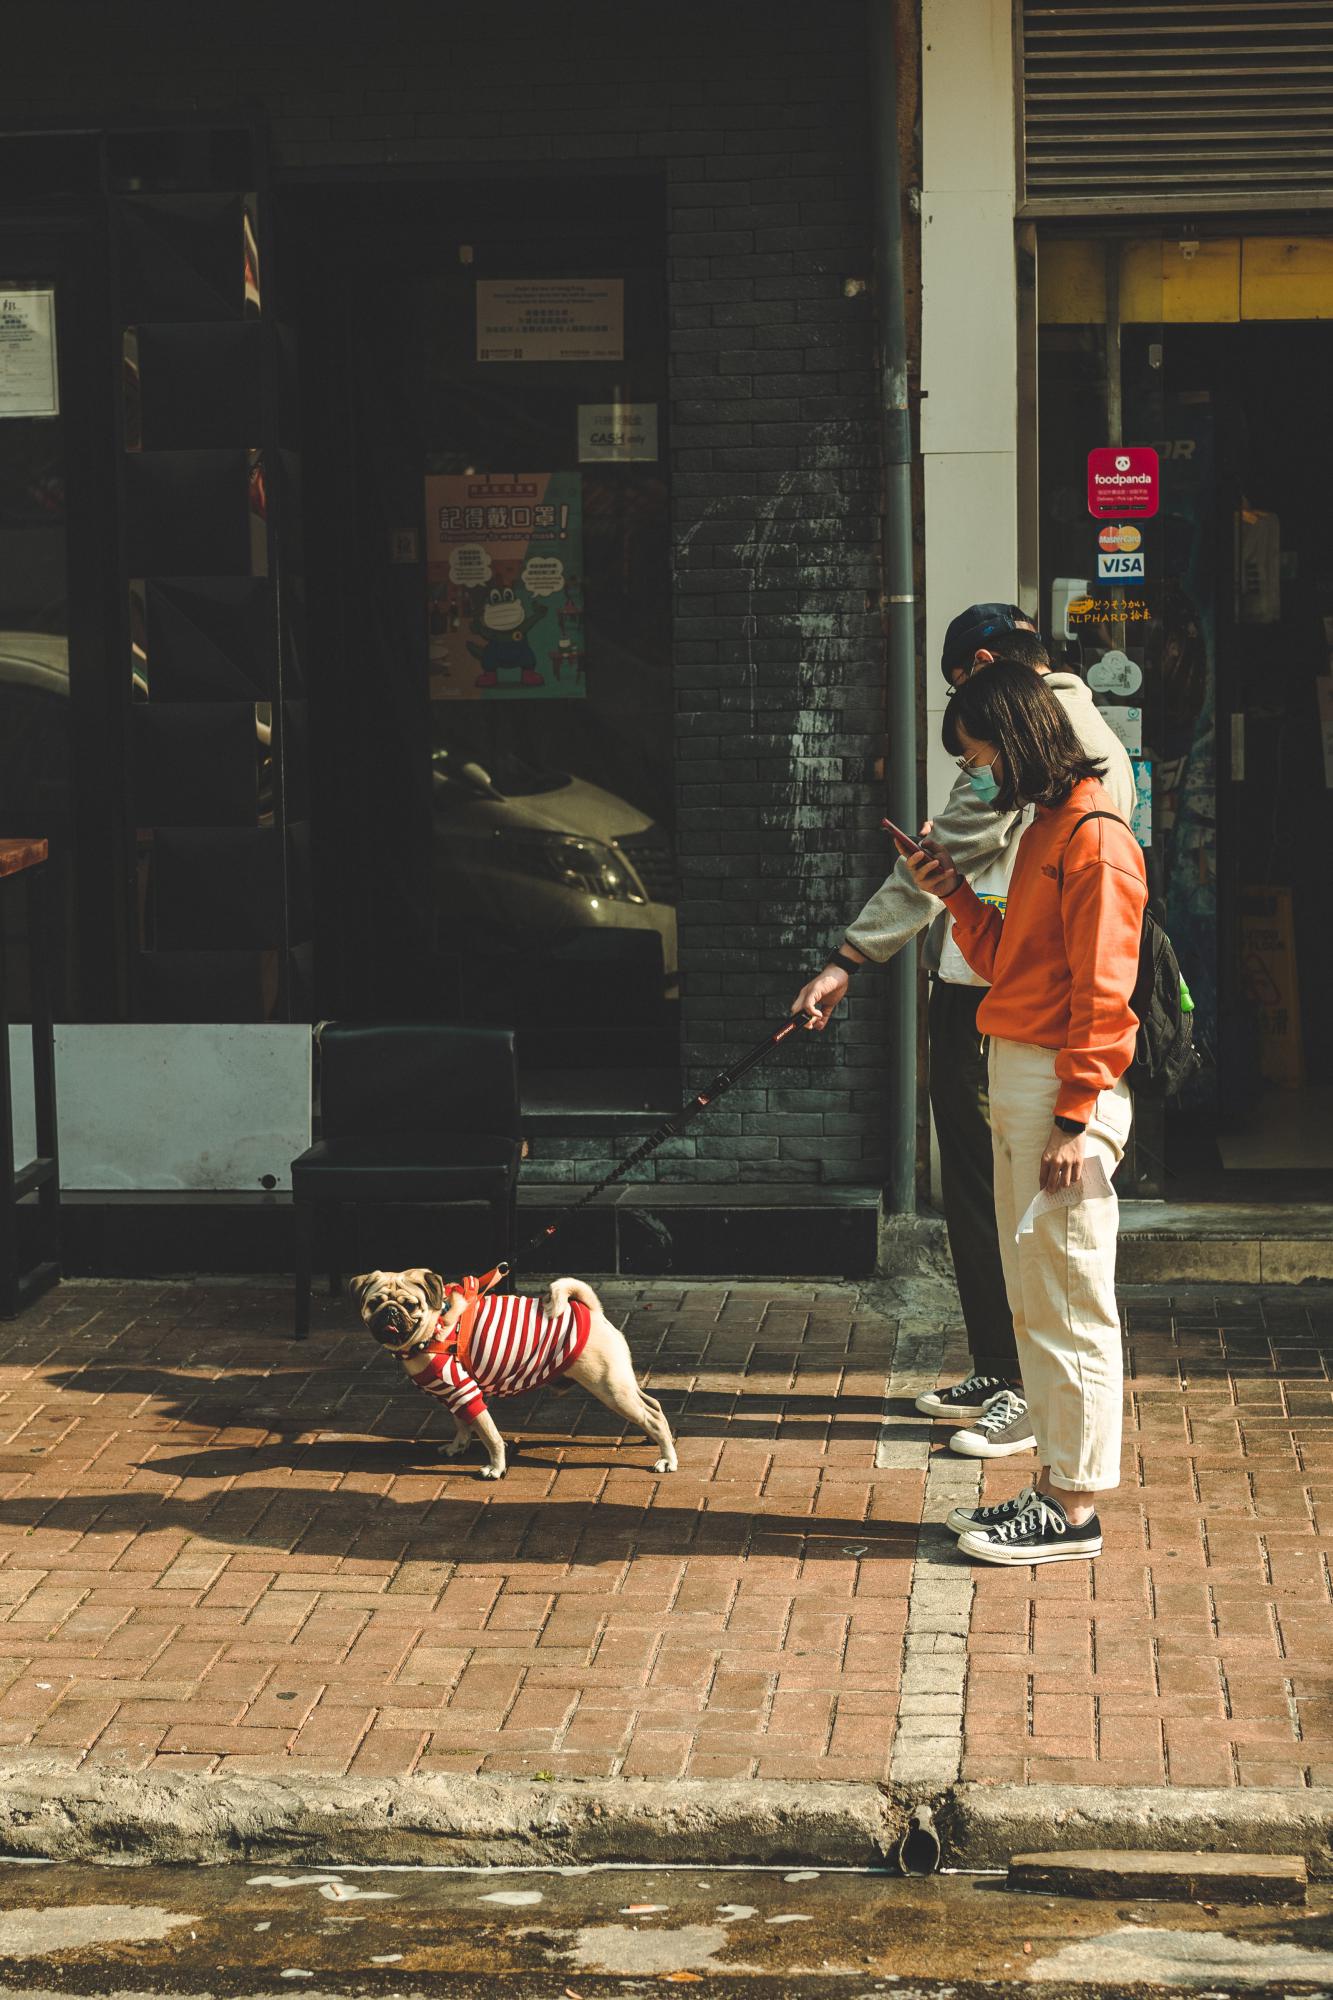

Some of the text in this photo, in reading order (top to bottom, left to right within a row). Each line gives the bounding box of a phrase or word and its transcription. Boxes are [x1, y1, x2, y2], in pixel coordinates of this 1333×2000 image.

[1094, 473, 1151, 486] foodpanda
[1103, 558, 1142, 572] VISA
[1069, 612, 1128, 624] ALPHARD
